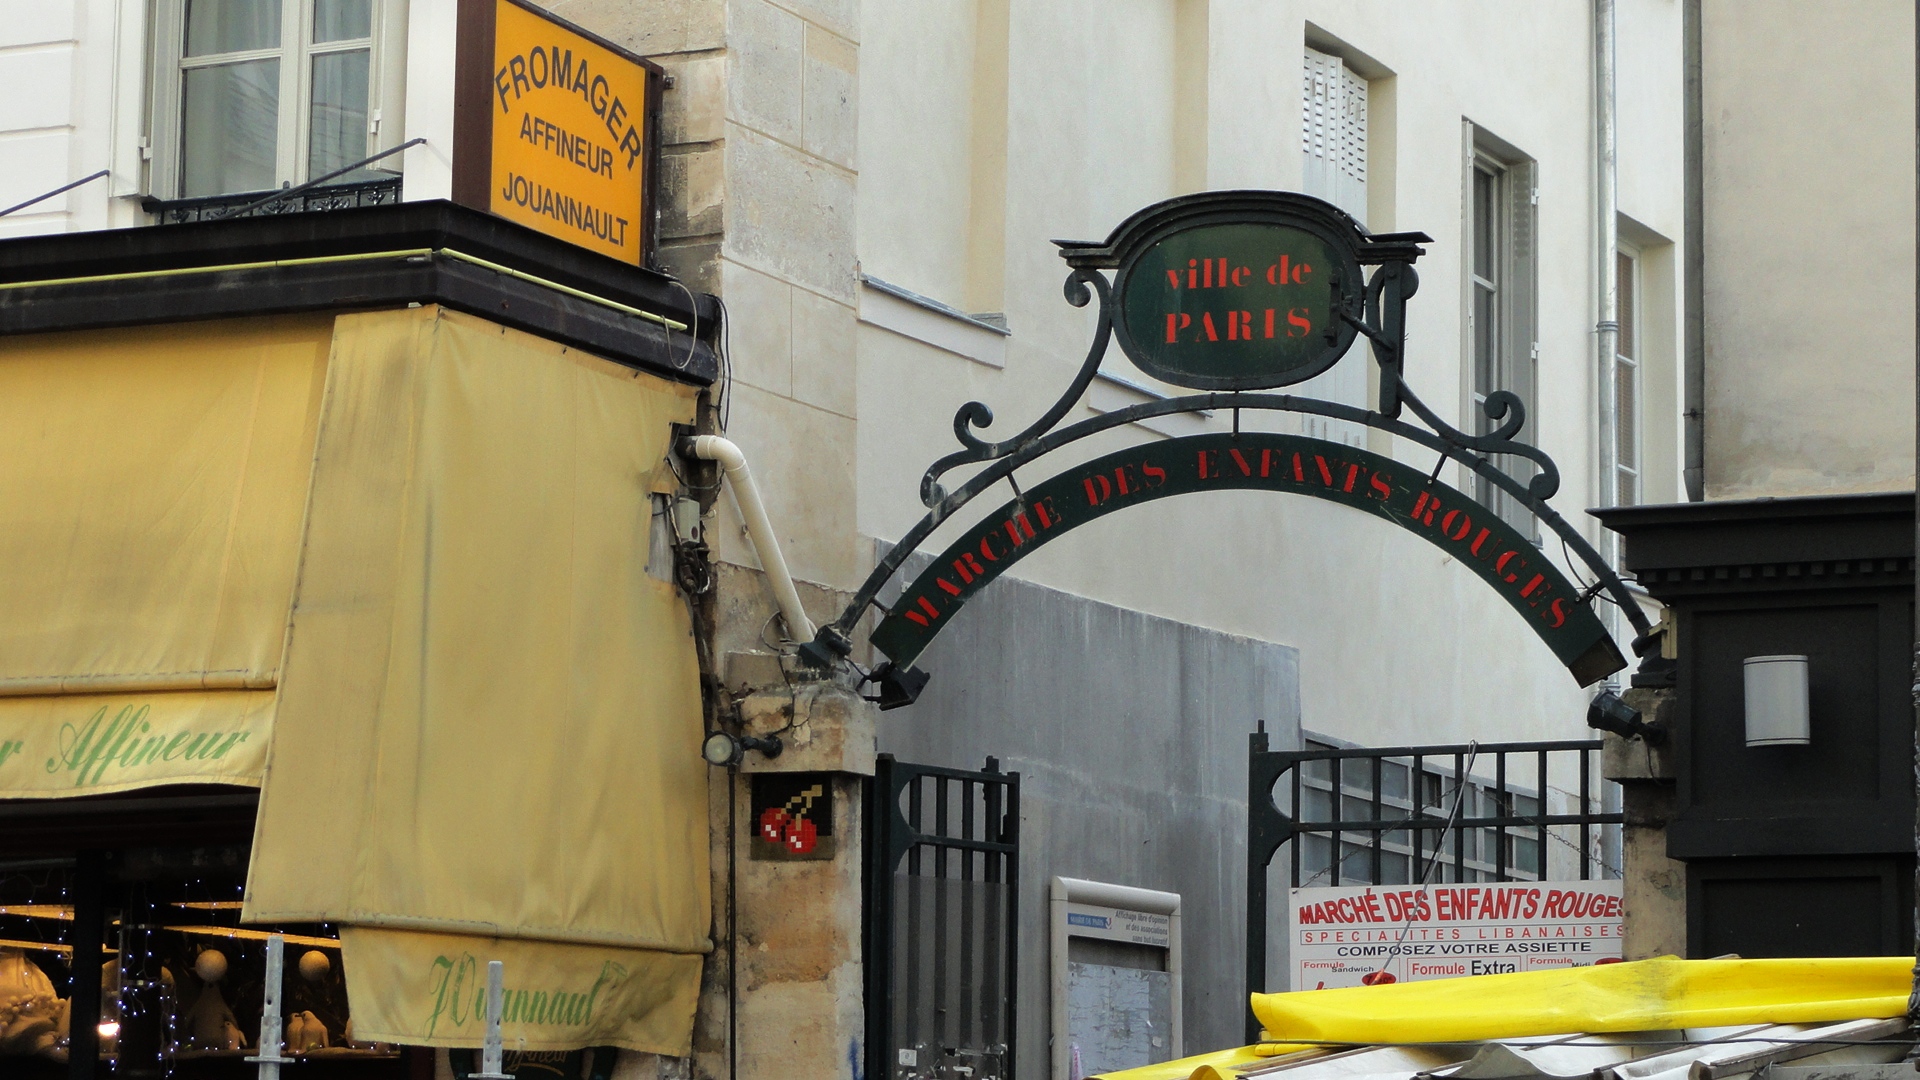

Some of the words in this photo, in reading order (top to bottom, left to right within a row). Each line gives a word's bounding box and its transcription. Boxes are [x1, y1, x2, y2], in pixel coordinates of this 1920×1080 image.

[495, 45, 642, 171] FROMAGER
[519, 112, 614, 180] AFFINEUR
[502, 172, 628, 247] JOUANNAULT
[1166, 257, 1251, 290] ville
[1266, 254, 1312, 286] de
[1166, 307, 1312, 344] PARIS
[904, 496, 1063, 632] MARCHE
[1083, 459, 1168, 507] DES
[1197, 448, 1392, 503] ENFANTS
[1411, 490, 1574, 629] ROUGES
[46, 704, 251, 787] Affineur
[1299, 888, 1385, 925] MARCHÉ
[1388, 889, 1431, 922] DES
[1434, 887, 1541, 921] ENFANTS
[1305, 927, 1461, 943] SPECIALITES
[1478, 925, 1623, 940] LIBANAISES
[1337, 944, 1436, 957] COMPOSEZ
[1440, 943, 1500, 955] VOTRE
[1505, 941, 1591, 953] ASSIETTE
[1303, 961, 1345, 969] Formule
[1411, 962, 1465, 976] Formule
[1471, 960, 1516, 976] Extra
[1530, 957, 1573, 965] Formule
